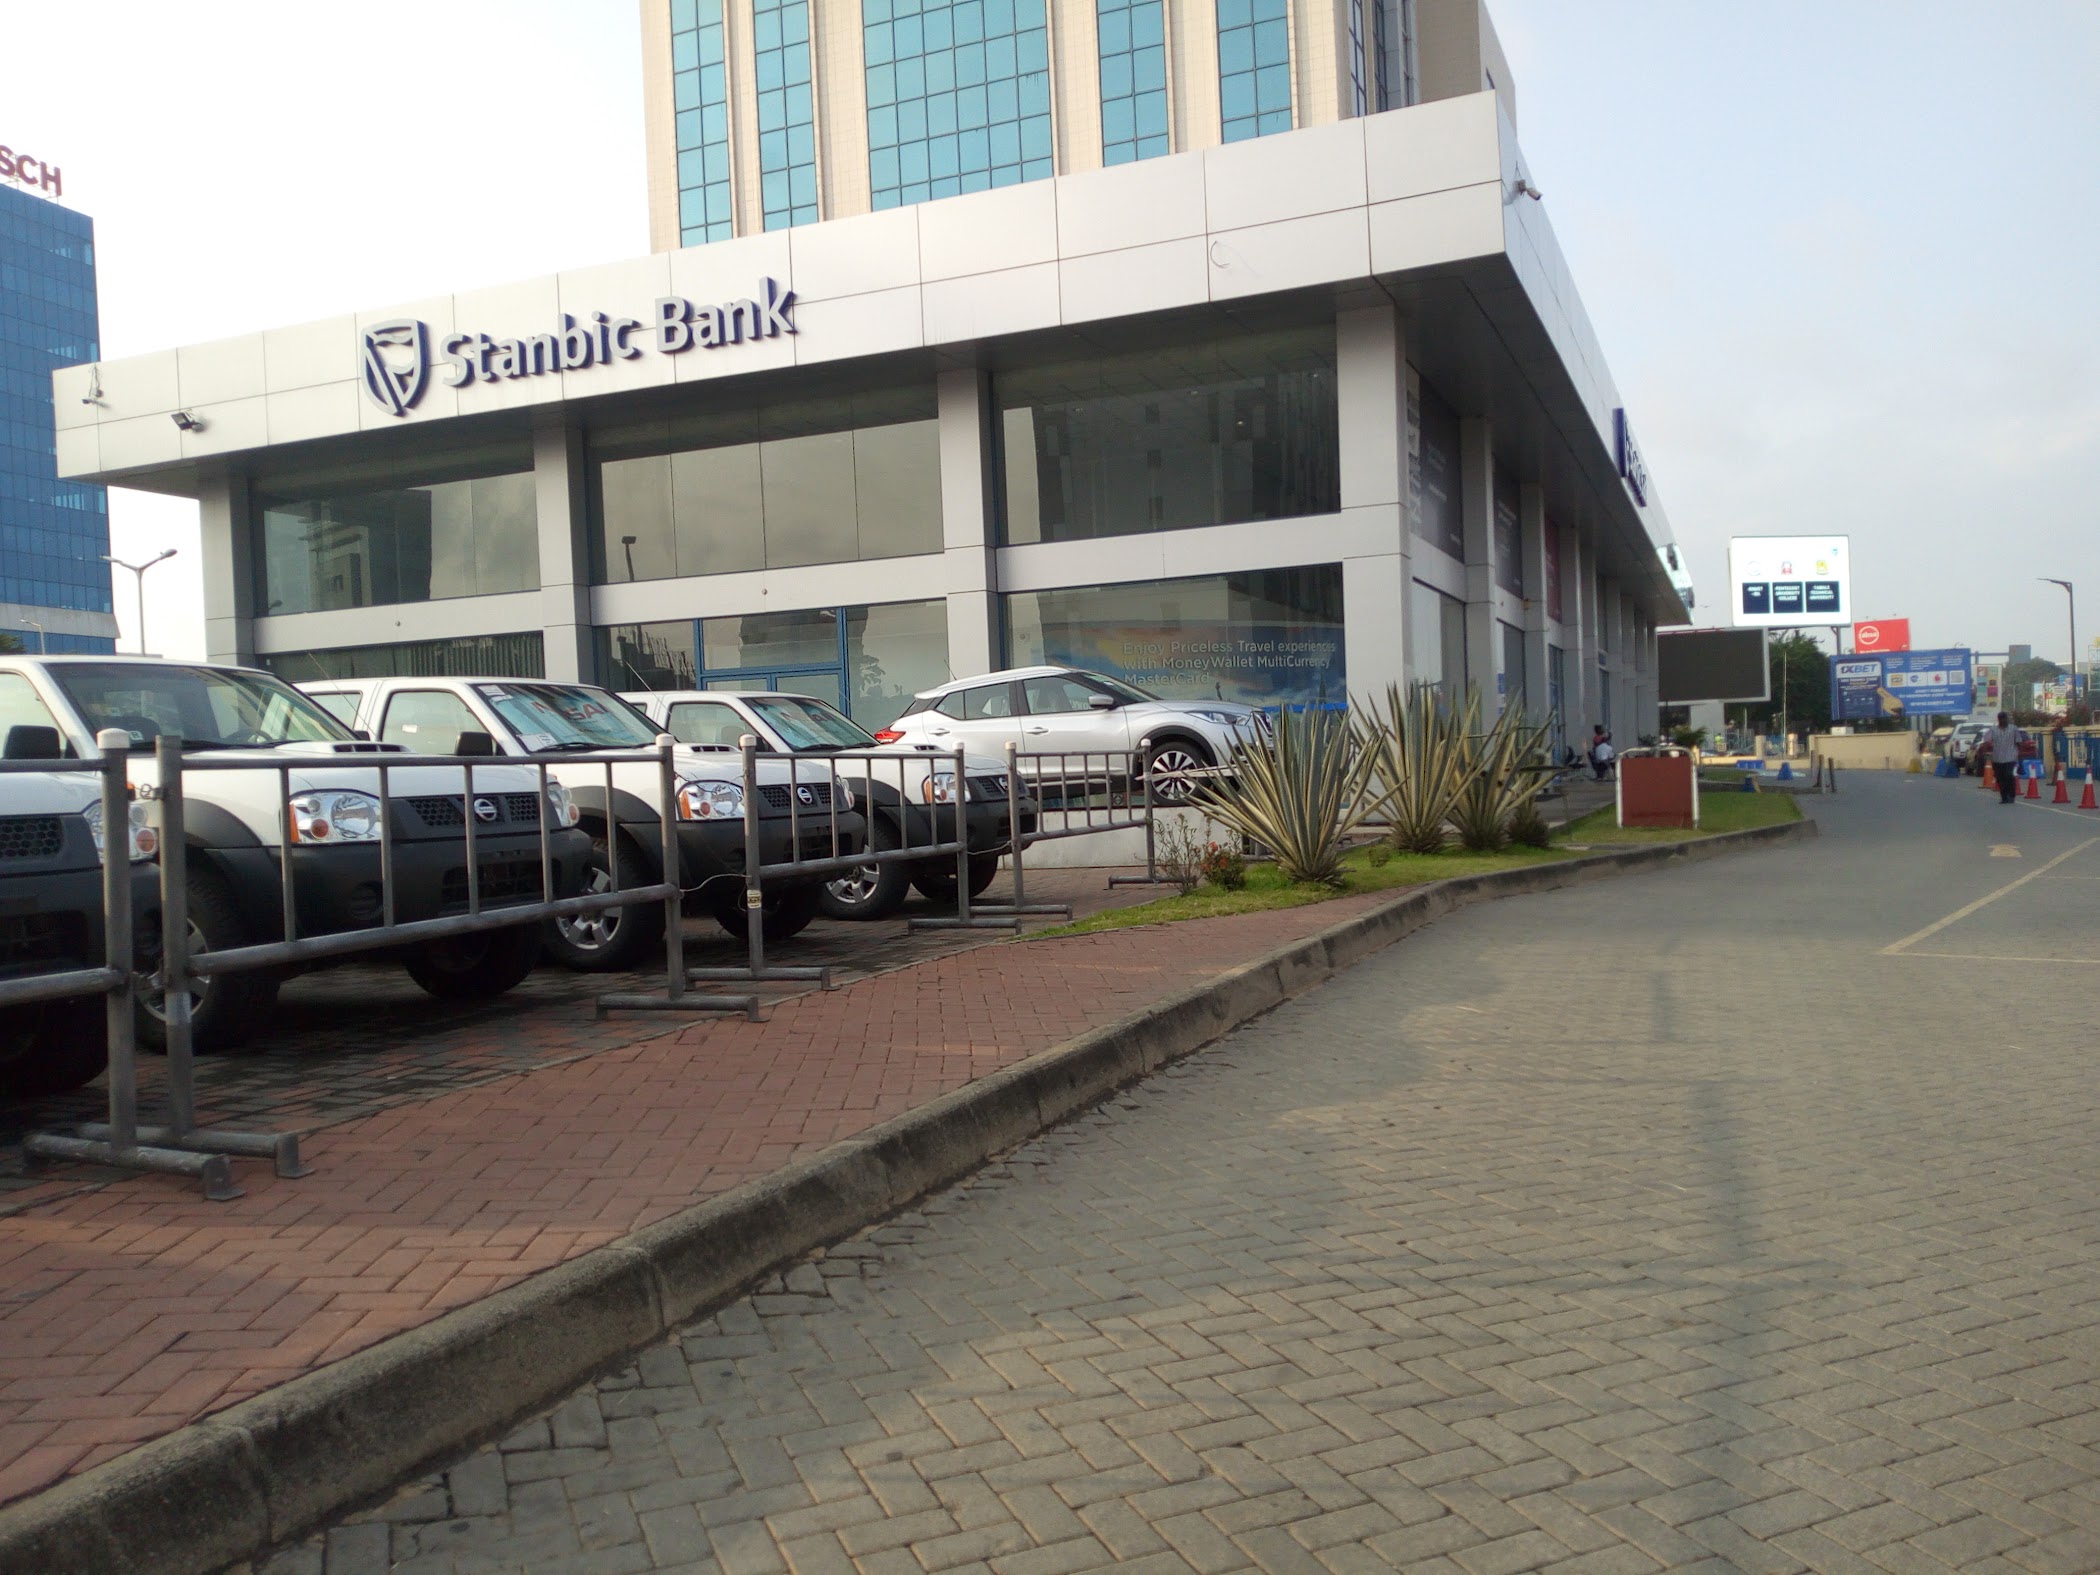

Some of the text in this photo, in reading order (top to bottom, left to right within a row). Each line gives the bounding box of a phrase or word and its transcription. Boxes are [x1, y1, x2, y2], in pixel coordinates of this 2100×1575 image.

[440, 276, 797, 387] Stanbic Bank
[1123, 640, 1336, 656] Enjoy Priceless Travel experiences
[1123, 658, 1156, 670] with
[1257, 655, 1331, 669] MultiCurrency
[1123, 672, 1210, 686] MasterCard
